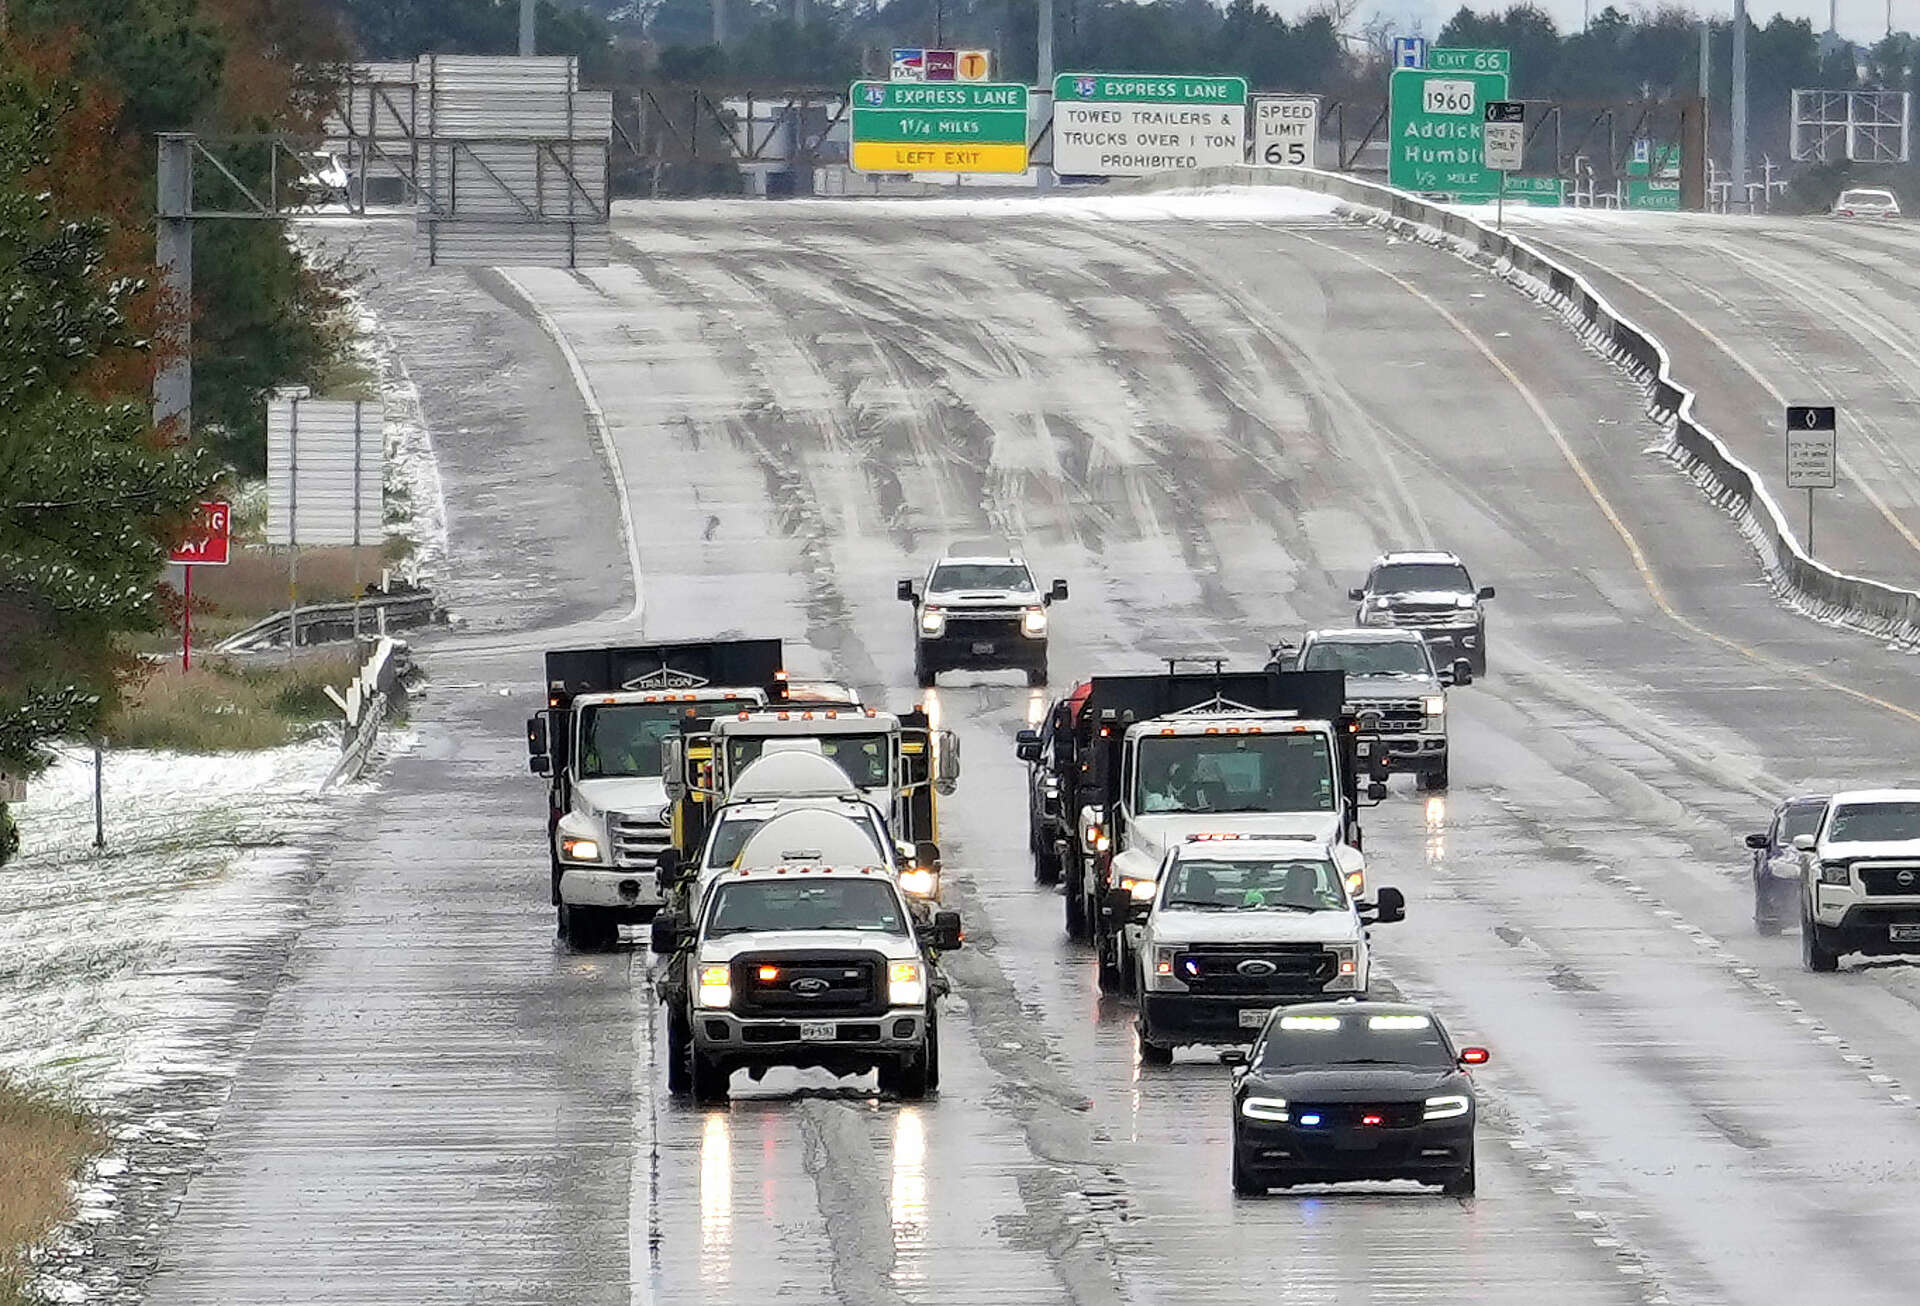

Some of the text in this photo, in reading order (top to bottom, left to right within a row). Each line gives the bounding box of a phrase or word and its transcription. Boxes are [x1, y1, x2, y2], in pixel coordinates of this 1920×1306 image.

[1398, 38, 1421, 68] H
[1436, 53, 1500, 69] EXIT 66
[864, 89, 1017, 105] 45 EXPRESS LANE
[1075, 82, 1227, 98] 45 EXPRESS LANE
[1427, 92, 1471, 110] 1960
[1067, 109, 1232, 126] TOWED TRAILERS &
[1260, 105, 1313, 119] SPEED
[939, 121, 980, 133] MILES
[1264, 123, 1306, 136] LIMIT
[1404, 121, 1483, 139] Addick
[1064, 131, 1127, 146] TRUCKS
[1137, 133, 1179, 147] OVER
[1205, 135, 1236, 148] TON
[896, 150, 980, 165] LEFT EXIT
[1101, 154, 1197, 169] PROHIBITED
[1263, 143, 1306, 165] 65
[1447, 173, 1480, 184] MILE
